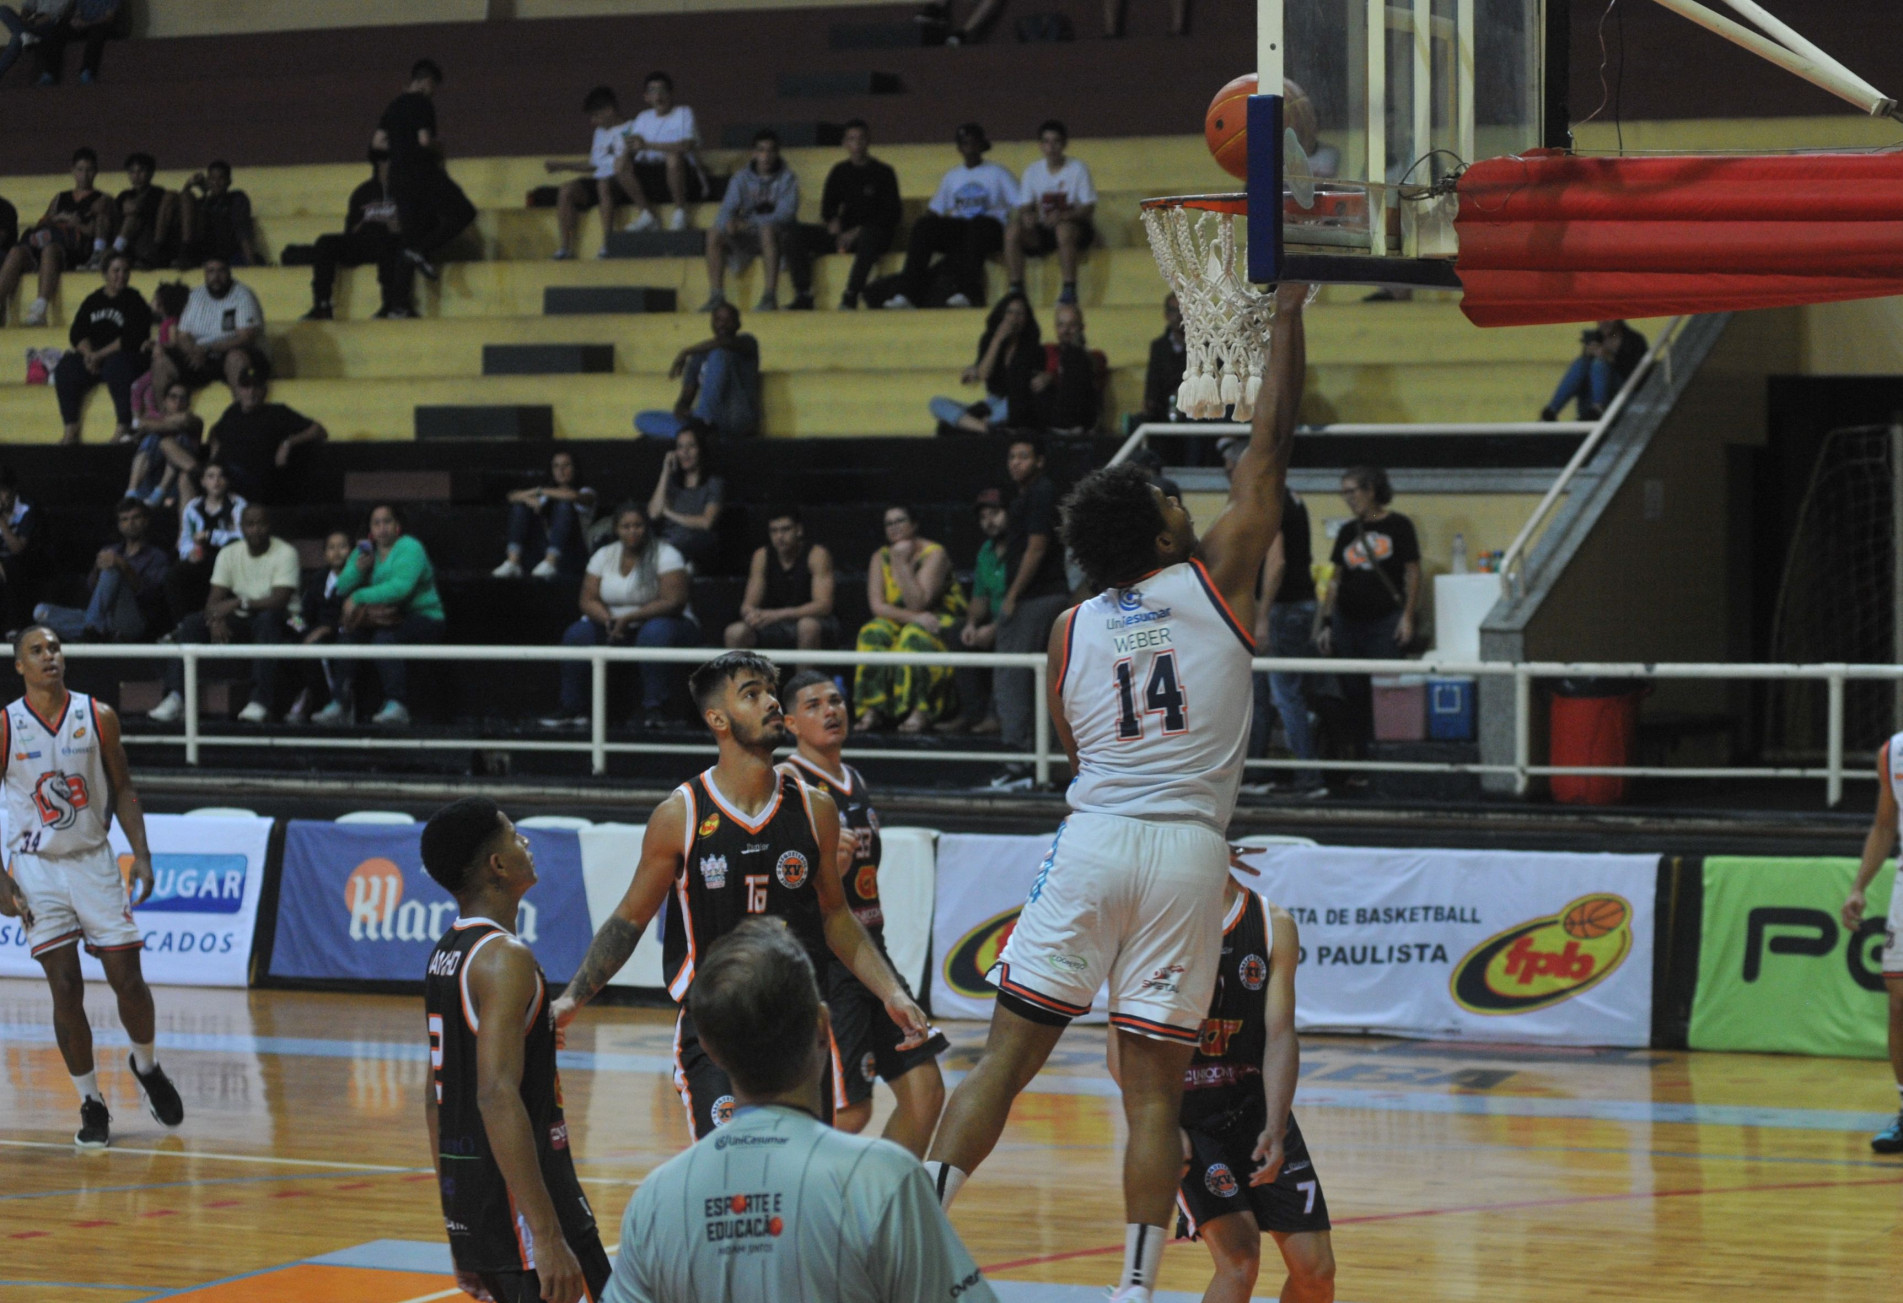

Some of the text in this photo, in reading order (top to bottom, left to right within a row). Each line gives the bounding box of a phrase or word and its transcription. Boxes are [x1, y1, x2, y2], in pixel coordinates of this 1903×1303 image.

[1114, 627, 1172, 653] WEBER
[1112, 648, 1189, 742] 14
[1326, 908, 1349, 925] DE
[1355, 906, 1481, 924] BASKETBALL
[1317, 943, 1448, 965] PAULISTA
[1504, 935, 1596, 985] fpb
[774, 1192, 781, 1212] E
[1297, 1180, 1316, 1214] 7
